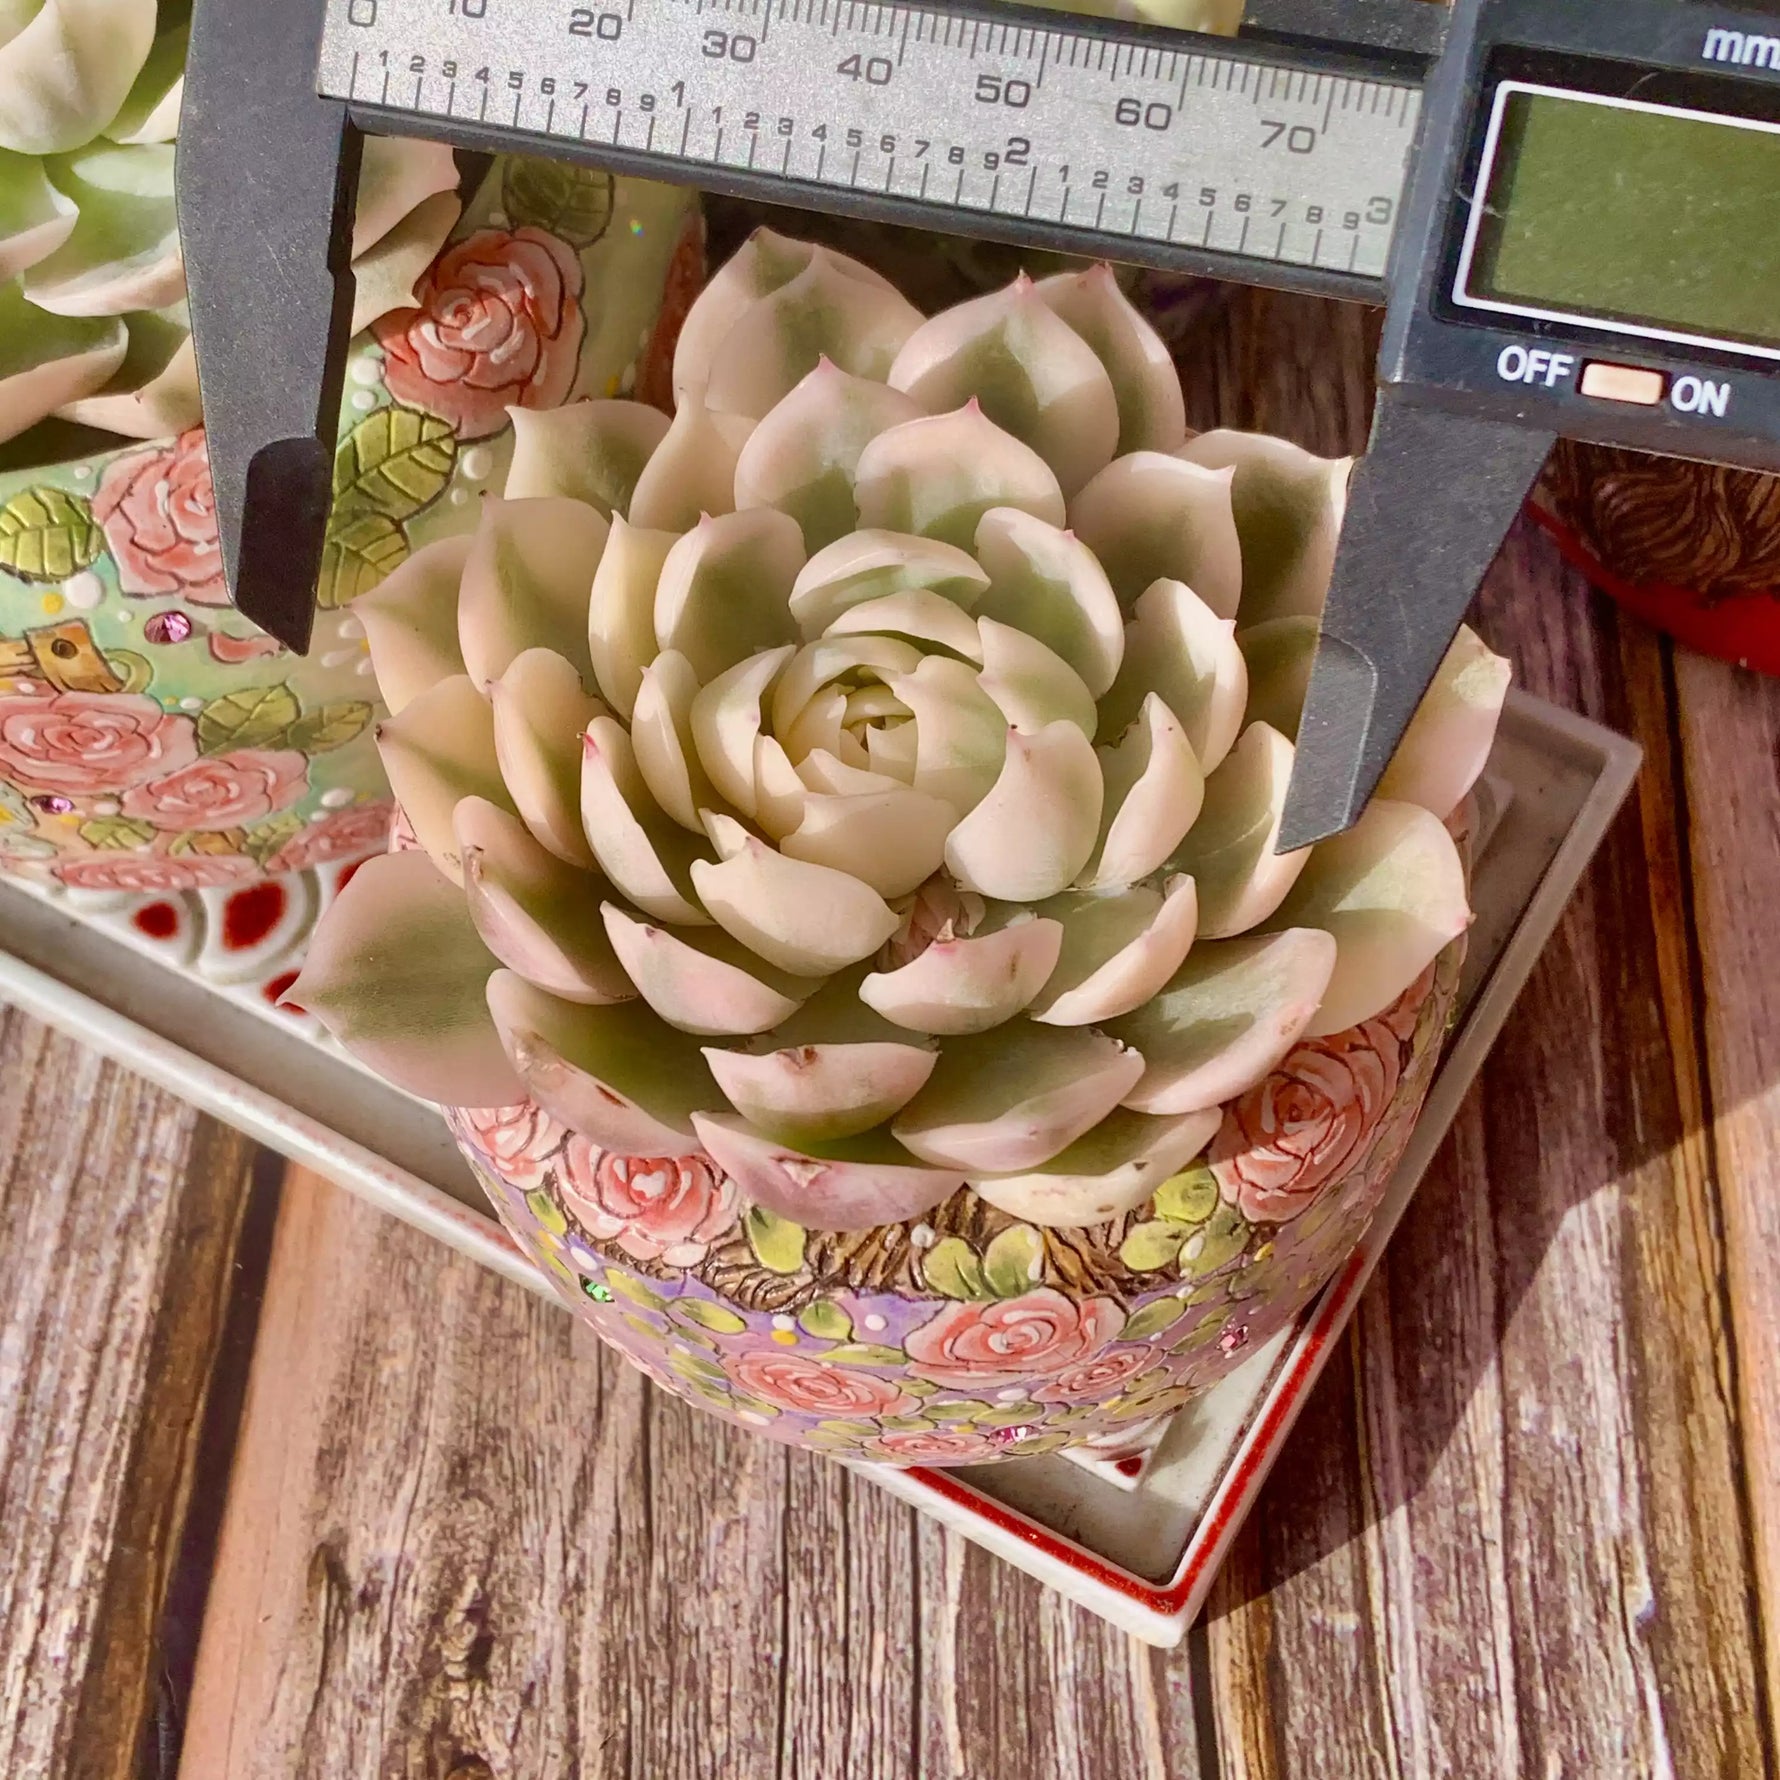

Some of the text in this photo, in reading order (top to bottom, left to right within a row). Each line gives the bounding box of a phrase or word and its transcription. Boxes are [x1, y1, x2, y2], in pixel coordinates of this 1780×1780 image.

[1701, 28, 1780, 71] mm
[568, 8, 622, 41] 20
[702, 30, 757, 64] 30
[836, 53, 893, 86] 40
[974, 73, 1032, 109] 50
[1114, 97, 1173, 132] 60
[1260, 119, 1317, 155] 70
[379, 50, 1393, 230] 1 2 3 4 5 6 7 8 9 1 1 2 3 4 5 6 7 8 9 2 1 2 3 4 5 6 7 8 9 3
[1496, 345, 1575, 388] OFF
[1670, 375, 1732, 418] ON
